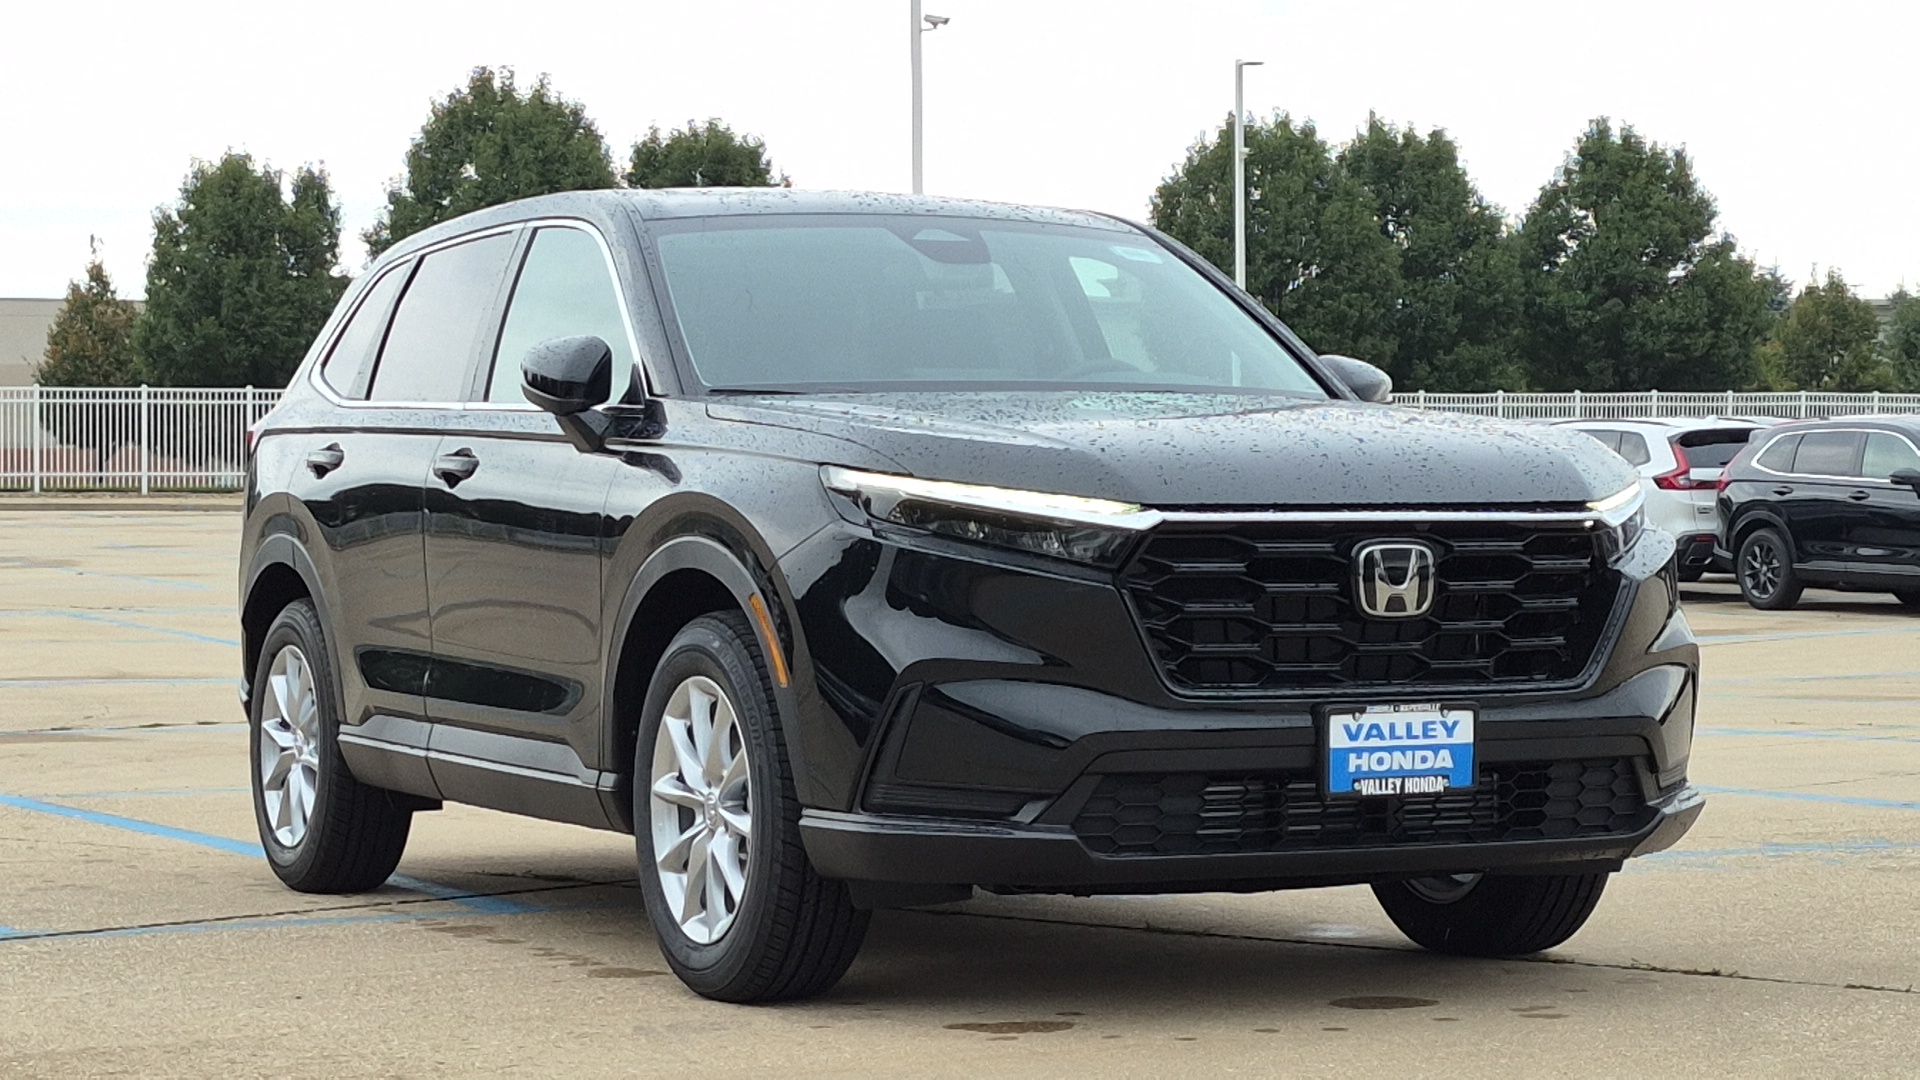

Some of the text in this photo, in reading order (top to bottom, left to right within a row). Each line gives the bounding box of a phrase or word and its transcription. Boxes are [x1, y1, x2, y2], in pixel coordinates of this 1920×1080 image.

[1342, 720, 1460, 742] VALLEY
[1348, 749, 1454, 773] HONDA
[1361, 776, 1444, 795] VALLEY HONDA
